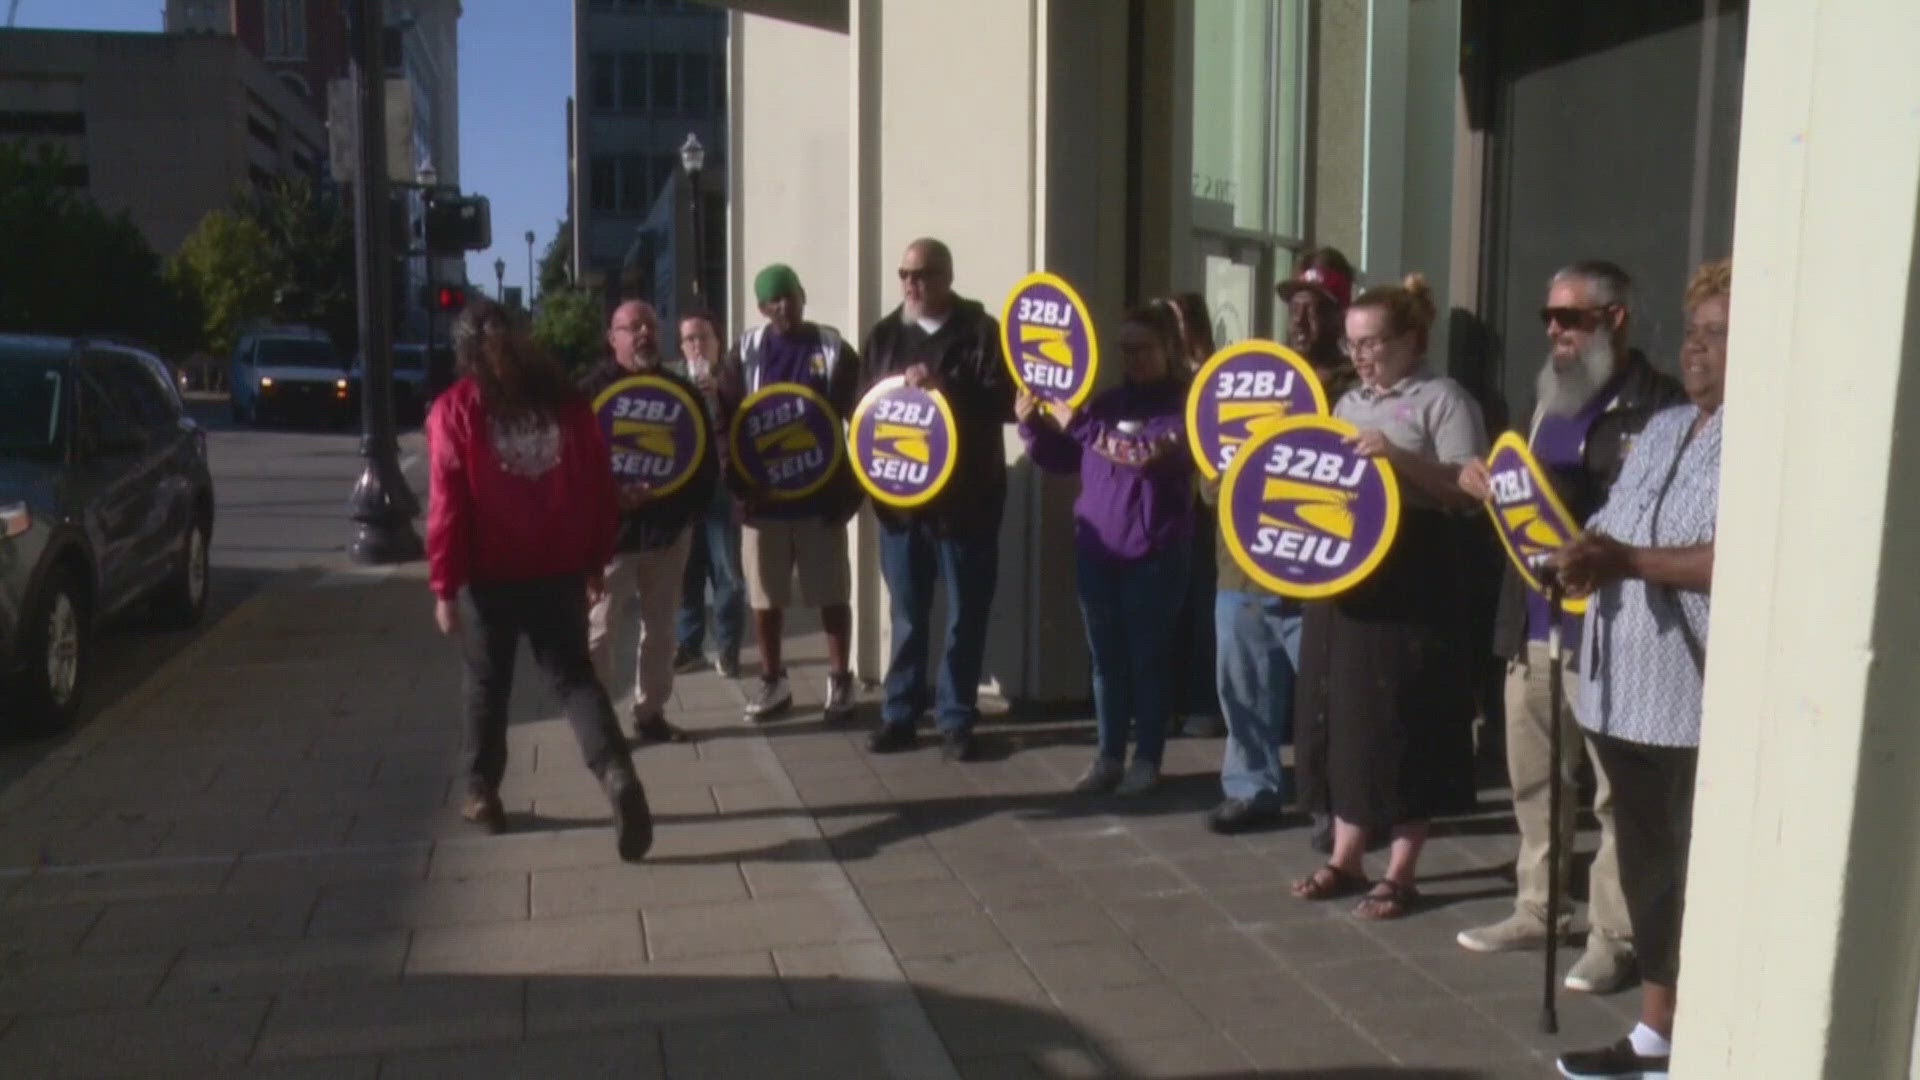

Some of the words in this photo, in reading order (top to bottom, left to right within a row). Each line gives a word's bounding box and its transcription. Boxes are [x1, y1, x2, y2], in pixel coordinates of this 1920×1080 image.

[1018, 297, 1072, 327] 32BJ
[1022, 361, 1073, 390] SEIU
[1215, 369, 1294, 399] 32BJ
[613, 396, 682, 422] 32BJ
[874, 399, 935, 427] 32BJ
[611, 452, 675, 476] SEIU
[869, 457, 929, 485] SEIU
[1264, 443, 1368, 487] 32BJ
[1250, 526, 1351, 568] SEIU
